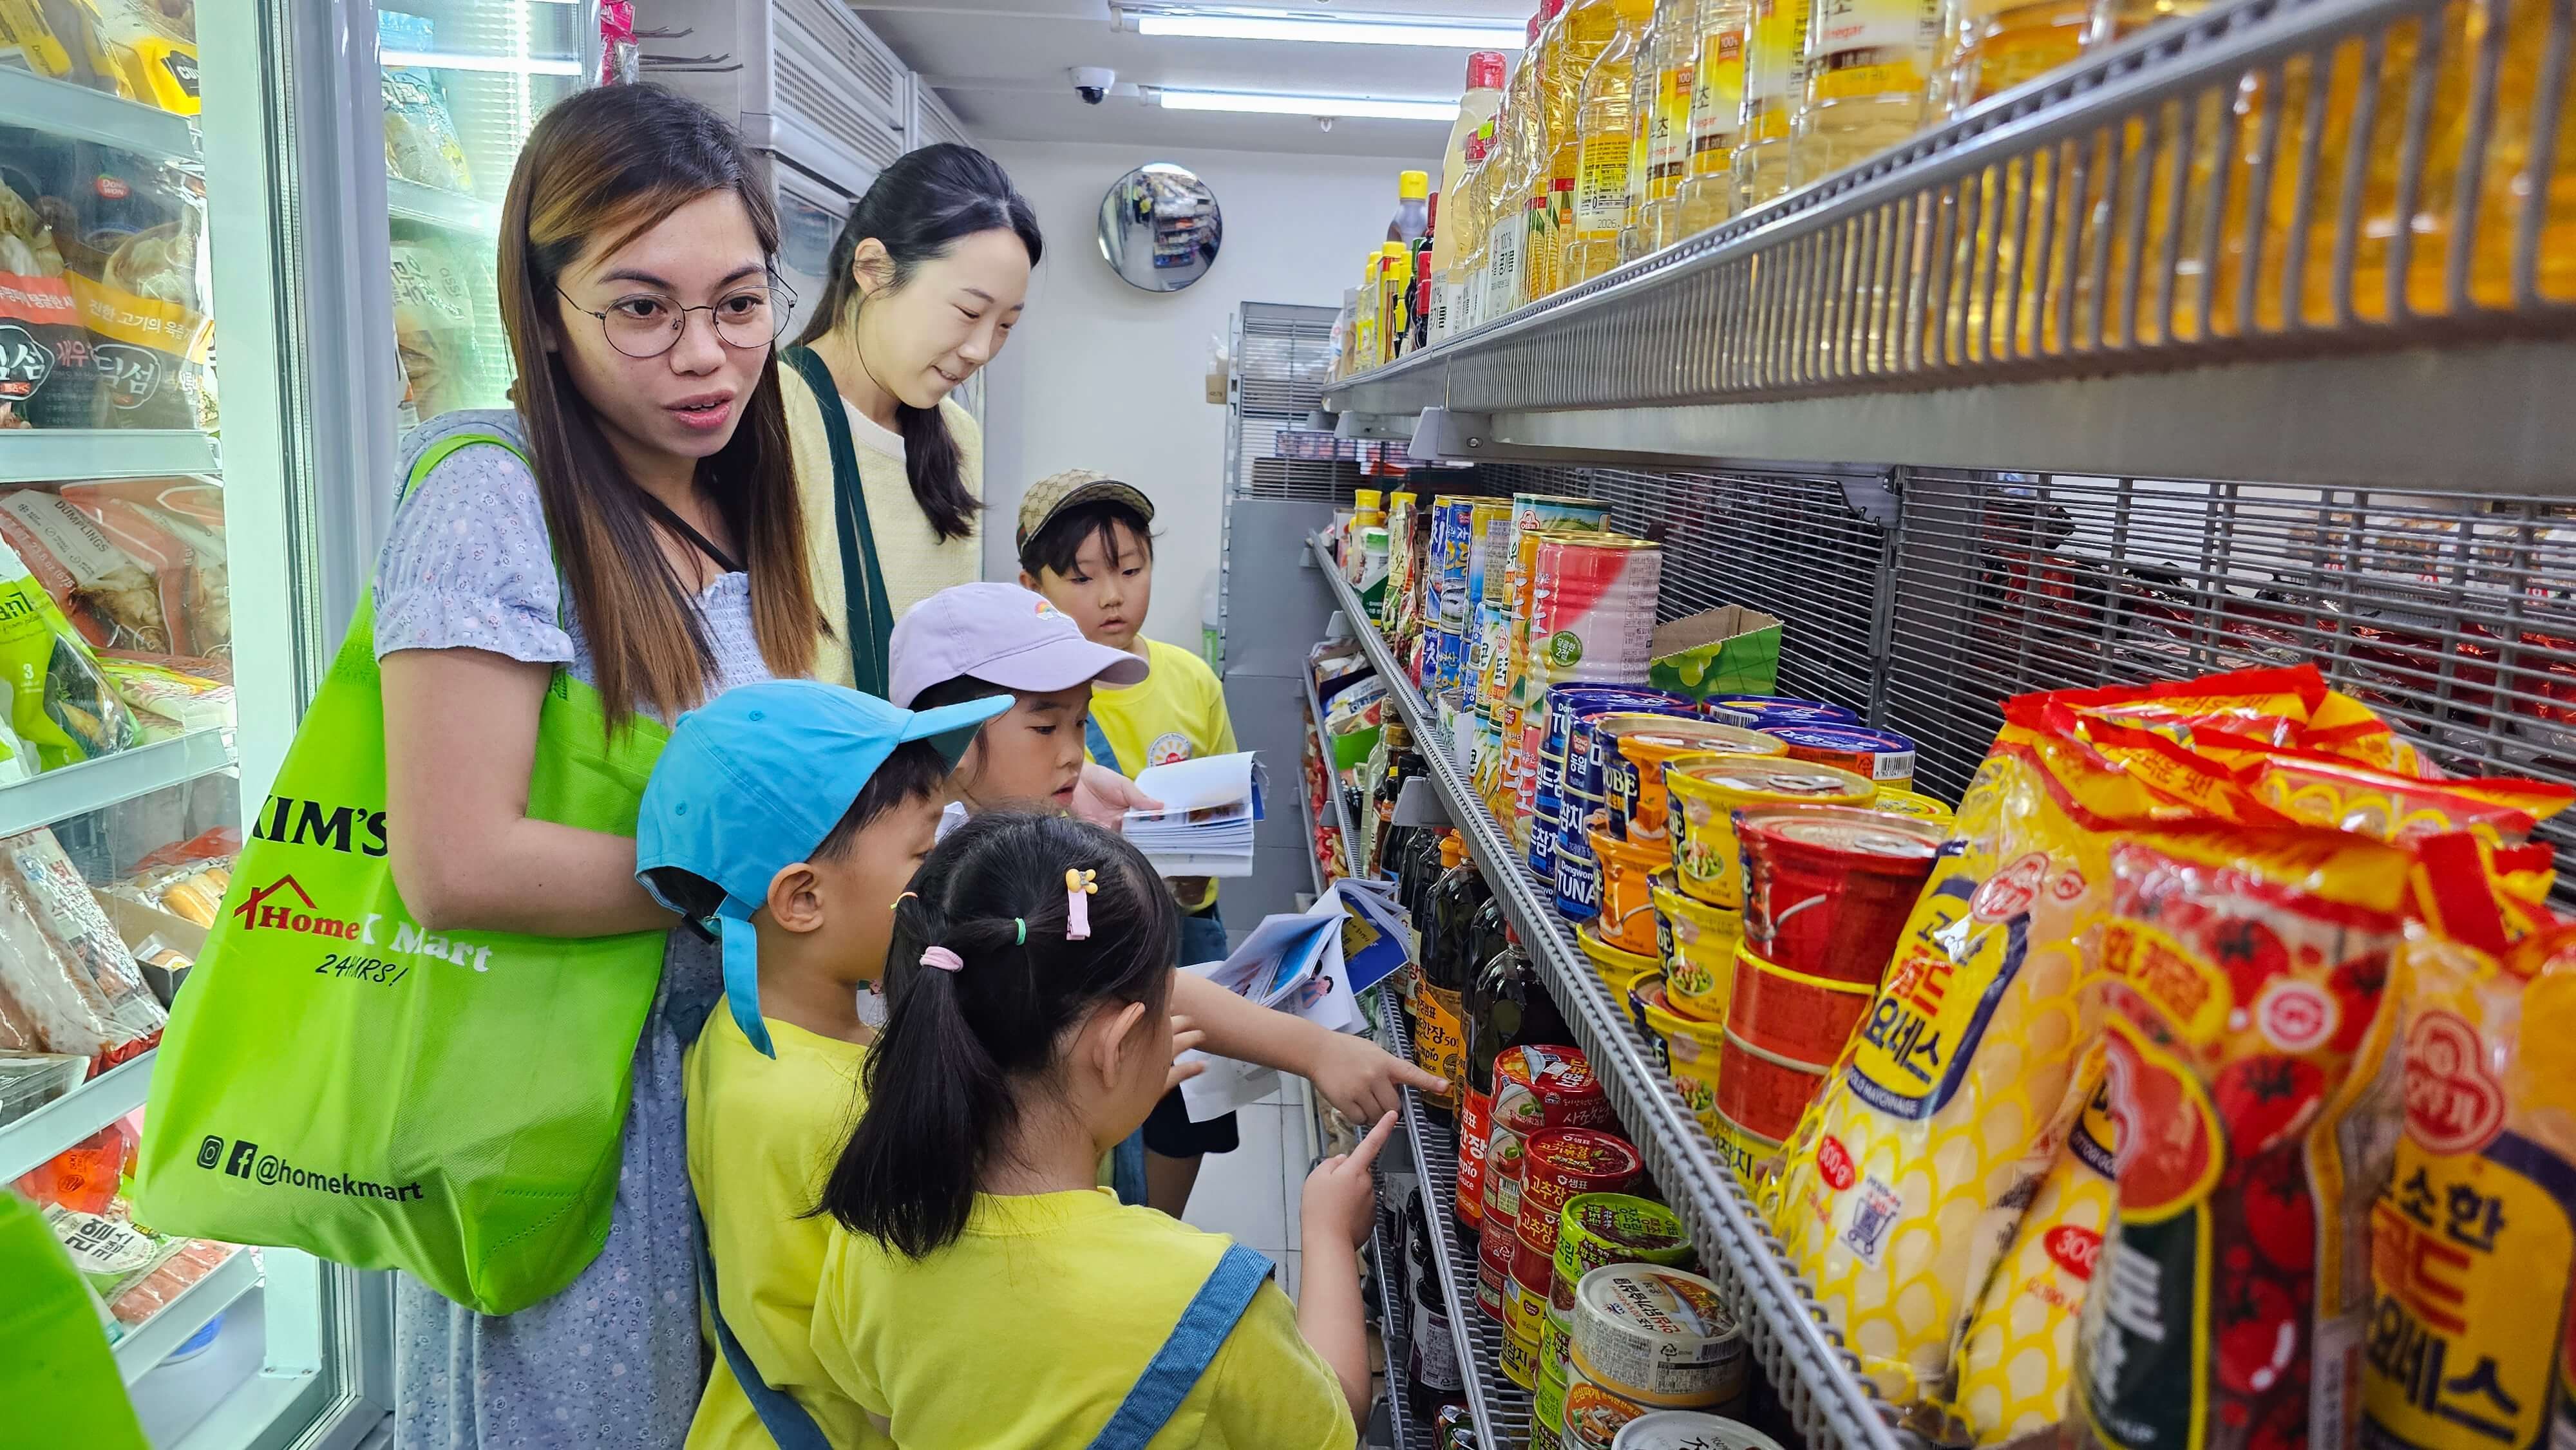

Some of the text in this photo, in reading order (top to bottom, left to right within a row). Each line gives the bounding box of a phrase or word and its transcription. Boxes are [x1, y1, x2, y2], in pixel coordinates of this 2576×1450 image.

[1678, 73, 1690, 83] 100
[54, 500, 109, 554] DUMPLINGS
[1570, 753, 1587, 775] 동원
[1604, 767, 1638, 797] UBE
[1560, 800, 1584, 835] 참치
[1557, 869, 1596, 905] TUNA
[1561, 859, 1594, 880] Dongwon
[389, 921, 494, 973] Mart
[1863, 998, 1942, 1085] 요네스
[256, 1154, 424, 1202] @homekmart
[1530, 1174, 1567, 1207] 고추장
[1568, 1178, 1587, 1190] 샘표
[2383, 1165, 2506, 1254] 소한
[1521, 1211, 1554, 1244] 고추장
[2367, 1290, 2521, 1445] 요네스
